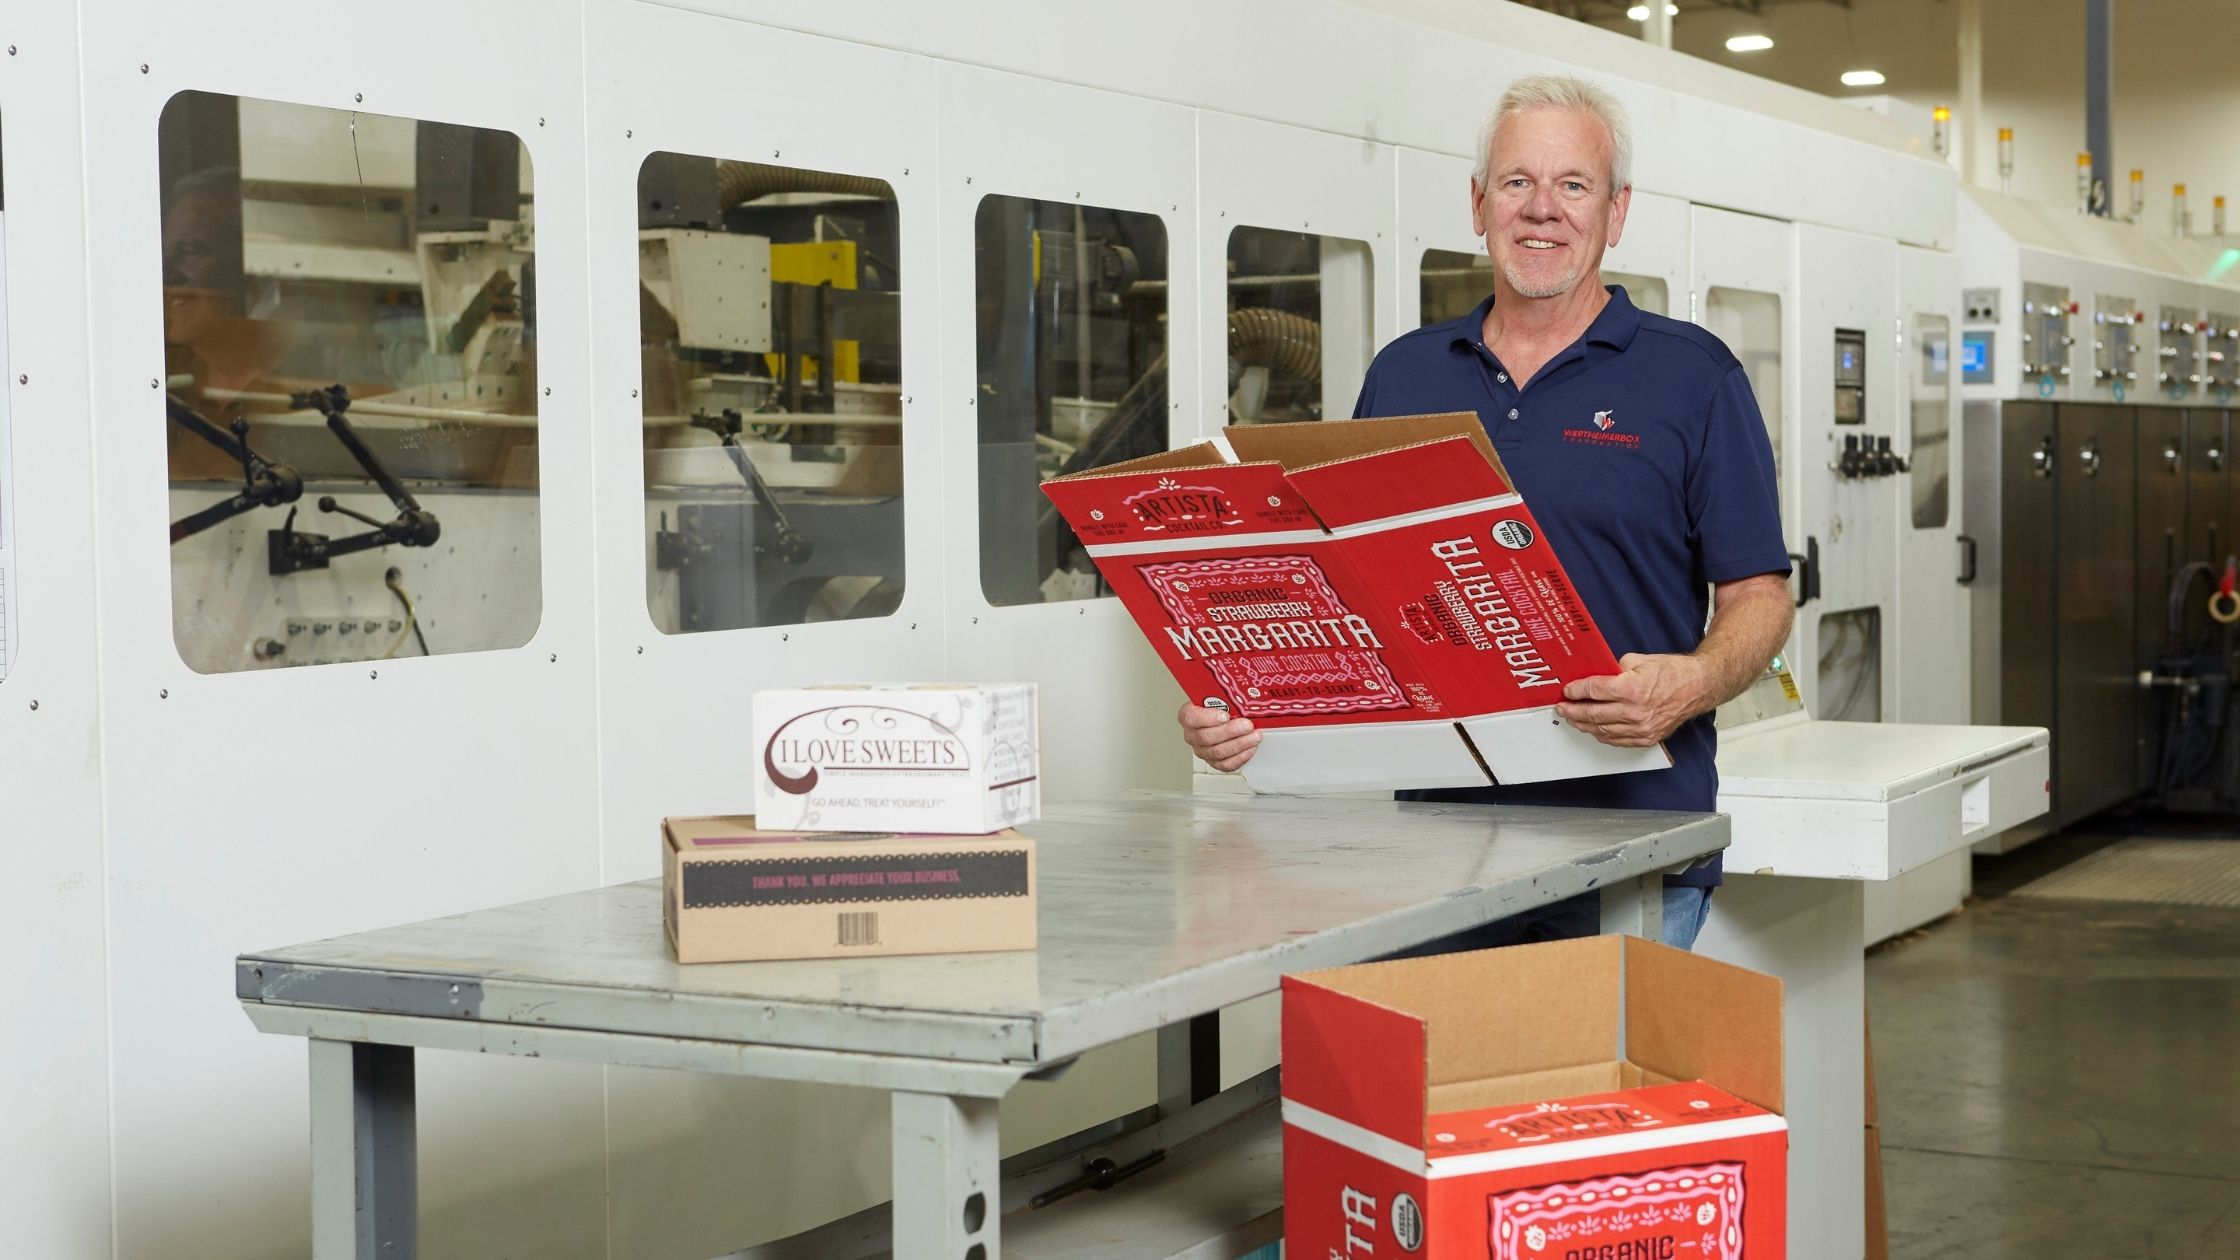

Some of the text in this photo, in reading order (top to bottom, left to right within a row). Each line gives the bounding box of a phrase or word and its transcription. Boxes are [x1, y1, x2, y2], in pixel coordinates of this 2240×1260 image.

[1563, 428, 1640, 443] WERTHEIMERBOX
[1137, 494, 1228, 522] ARTISTA
[1166, 520, 1209, 533] COCKTAIL
[1499, 526, 1515, 545] USDA
[1208, 587, 1288, 604] ORGANIC
[1496, 568, 1553, 641] WINE COCKTAIL
[1546, 569, 1590, 632] READY-TO-SERVE
[1206, 602, 1314, 624] STRAWBERRY
[1405, 607, 1438, 641] ARTISTA
[1424, 592, 1469, 646] ORGANIC
[1431, 535, 1561, 689] MARGARITA
[1433, 580, 1493, 651] STRAWBERRY
[1163, 614, 1386, 661] MARGARITA
[1252, 652, 1339, 675] WINE COCKTAIL
[1268, 684, 1359, 698] READY-TO-SERVE
[781, 739, 956, 765] I LOVE SWEETS
[812, 798, 826, 808] GO
[863, 798, 890, 808] TREAT
[752, 875, 785, 889] THANK
[812, 873, 827, 888] WE
[829, 871, 884, 887] APPRECIATE
[886, 871, 913, 885] YOUR
[1507, 1107, 1637, 1138] ARTISTA
[1398, 1204, 1406, 1237] USDA
